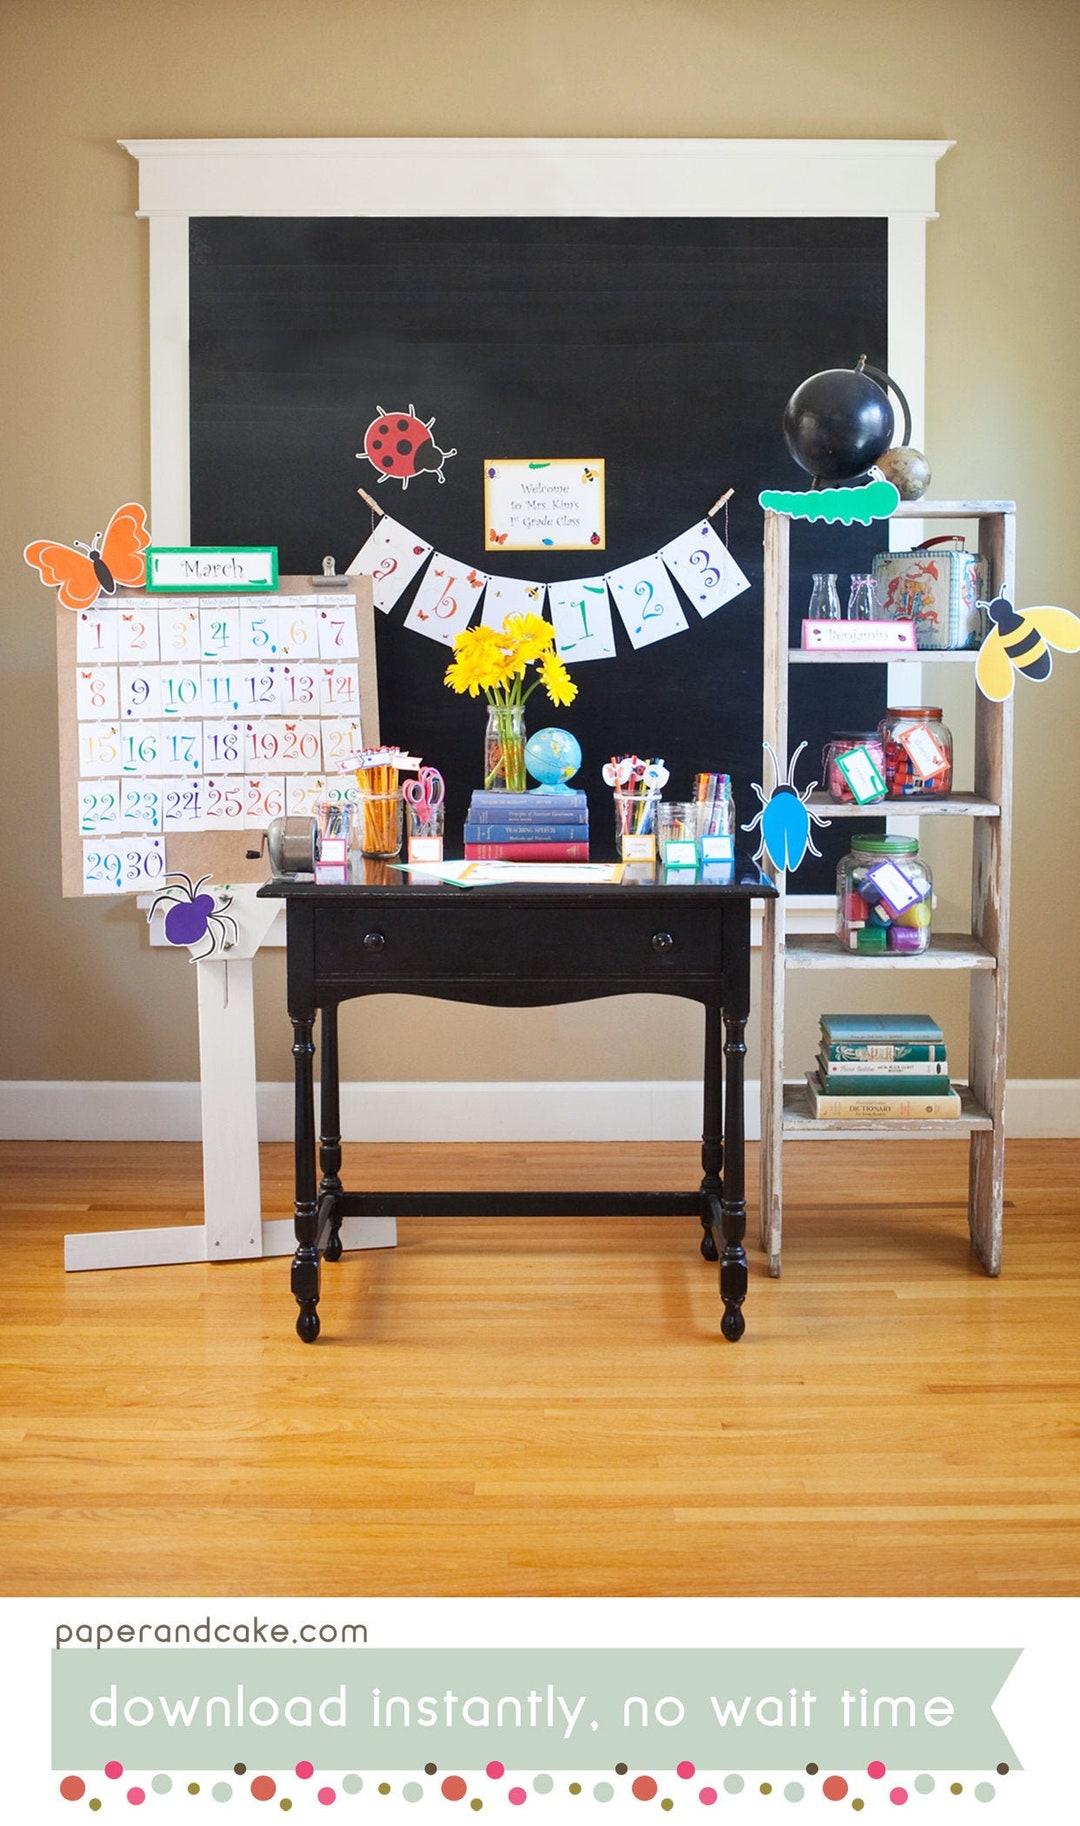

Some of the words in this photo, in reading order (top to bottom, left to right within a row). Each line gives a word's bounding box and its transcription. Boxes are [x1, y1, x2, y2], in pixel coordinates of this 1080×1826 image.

[520, 483, 570, 494] Welcome
[510, 500, 522, 510] to
[522, 515, 554, 528] Grade
[556, 515, 581, 527] Class
[180, 557, 244, 579] March
[570, 599, 595, 641] 1
[634, 580, 665, 621] 2
[689, 549, 721, 588] 3
[90, 623, 104, 650] 1
[130, 622, 148, 649] 2
[172, 622, 188, 649] 3
[210, 621, 230, 649] 4
[251, 618, 270, 647] 5
[290, 619, 307, 645] 6
[330, 620, 346, 646] 7
[90, 679, 106, 707] 8
[131, 678, 150, 705] 9
[162, 678, 197, 705] 10
[207, 677, 234, 704] 11
[244, 675, 277, 704] 12
[284, 675, 315, 704] 13
[322, 676, 356, 704] 14
[83, 732, 118, 764] 15
[123, 735, 158, 763] 16
[166, 735, 197, 763] 17
[207, 733, 239, 762] 18
[246, 732, 279, 760] 19
[282, 731, 320, 760] 20
[82, 793, 118, 822] 22
[124, 791, 159, 821] 23
[165, 791, 202, 820] 24
[206, 787, 243, 818] 25
[246, 788, 283, 817] 26
[505, 825, 534, 834] TEACHING
[535, 825, 556, 834] SPEECH
[86, 852, 122, 881] 29
[126, 851, 163, 879] 30
[849, 1105, 892, 1113] DICTIONARY
